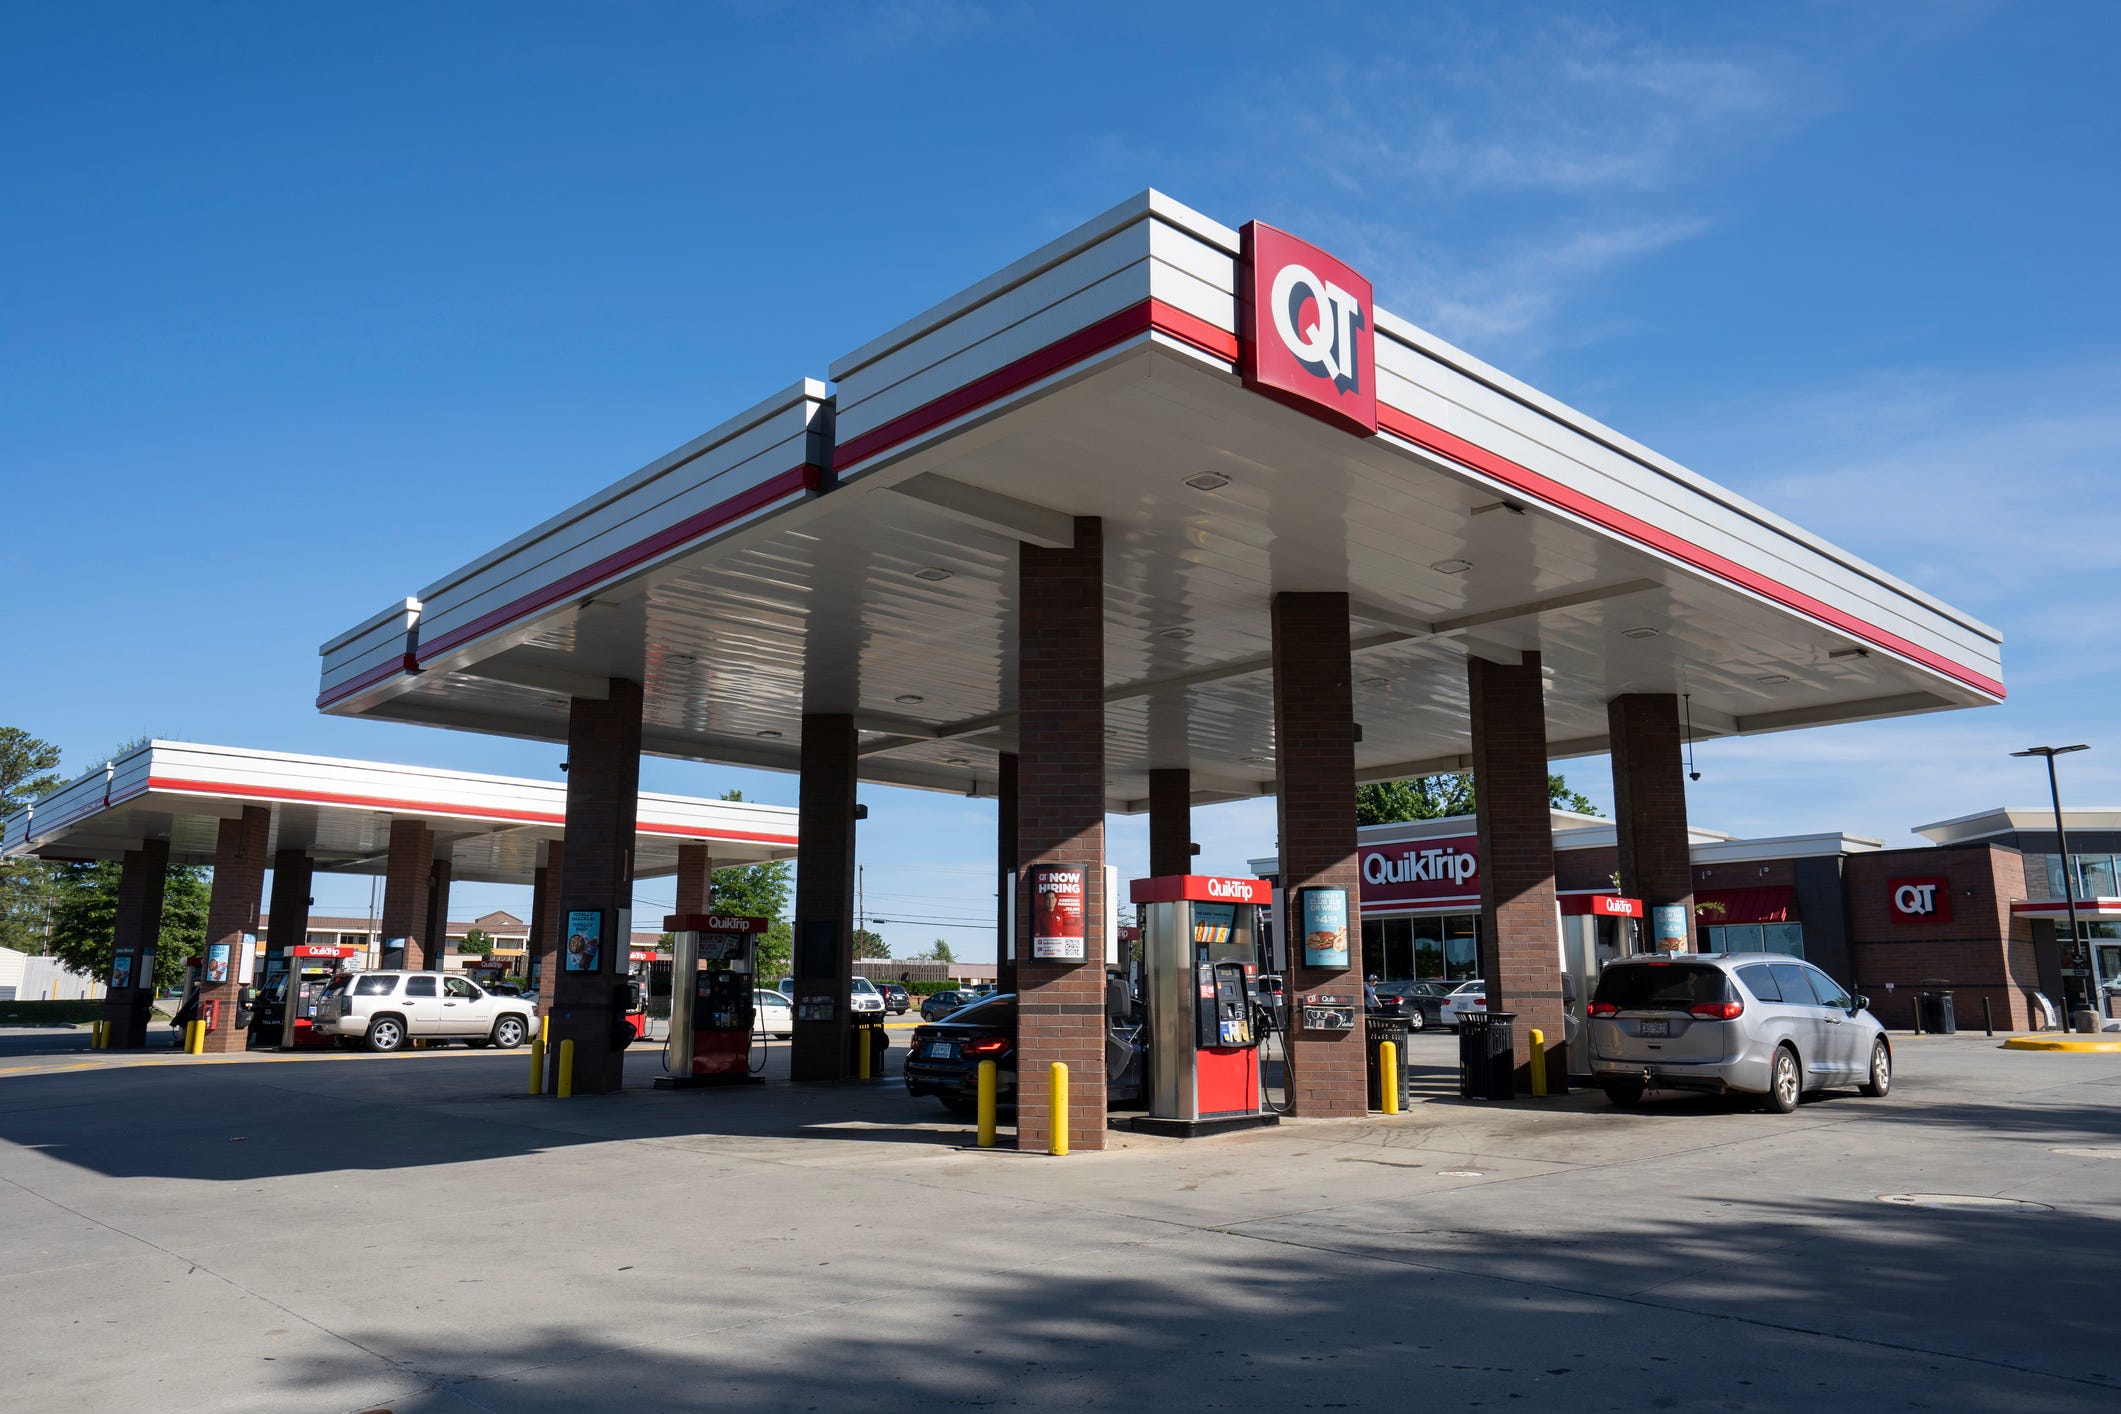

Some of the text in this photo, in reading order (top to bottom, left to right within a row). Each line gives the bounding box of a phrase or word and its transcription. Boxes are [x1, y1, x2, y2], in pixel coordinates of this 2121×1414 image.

[1271, 264, 1361, 384] QT
[1363, 847, 1476, 885] QuikTrip
[1049, 872, 1080, 883] NOW
[1038, 883, 1080, 894] HIRING
[1208, 878, 1253, 902] QuikTrip
[1606, 898, 1632, 916] QuikTrip
[1894, 884, 1936, 915] QT
[709, 916, 750, 932] QuikTrip
[309, 947, 340, 956] QuikTrip
